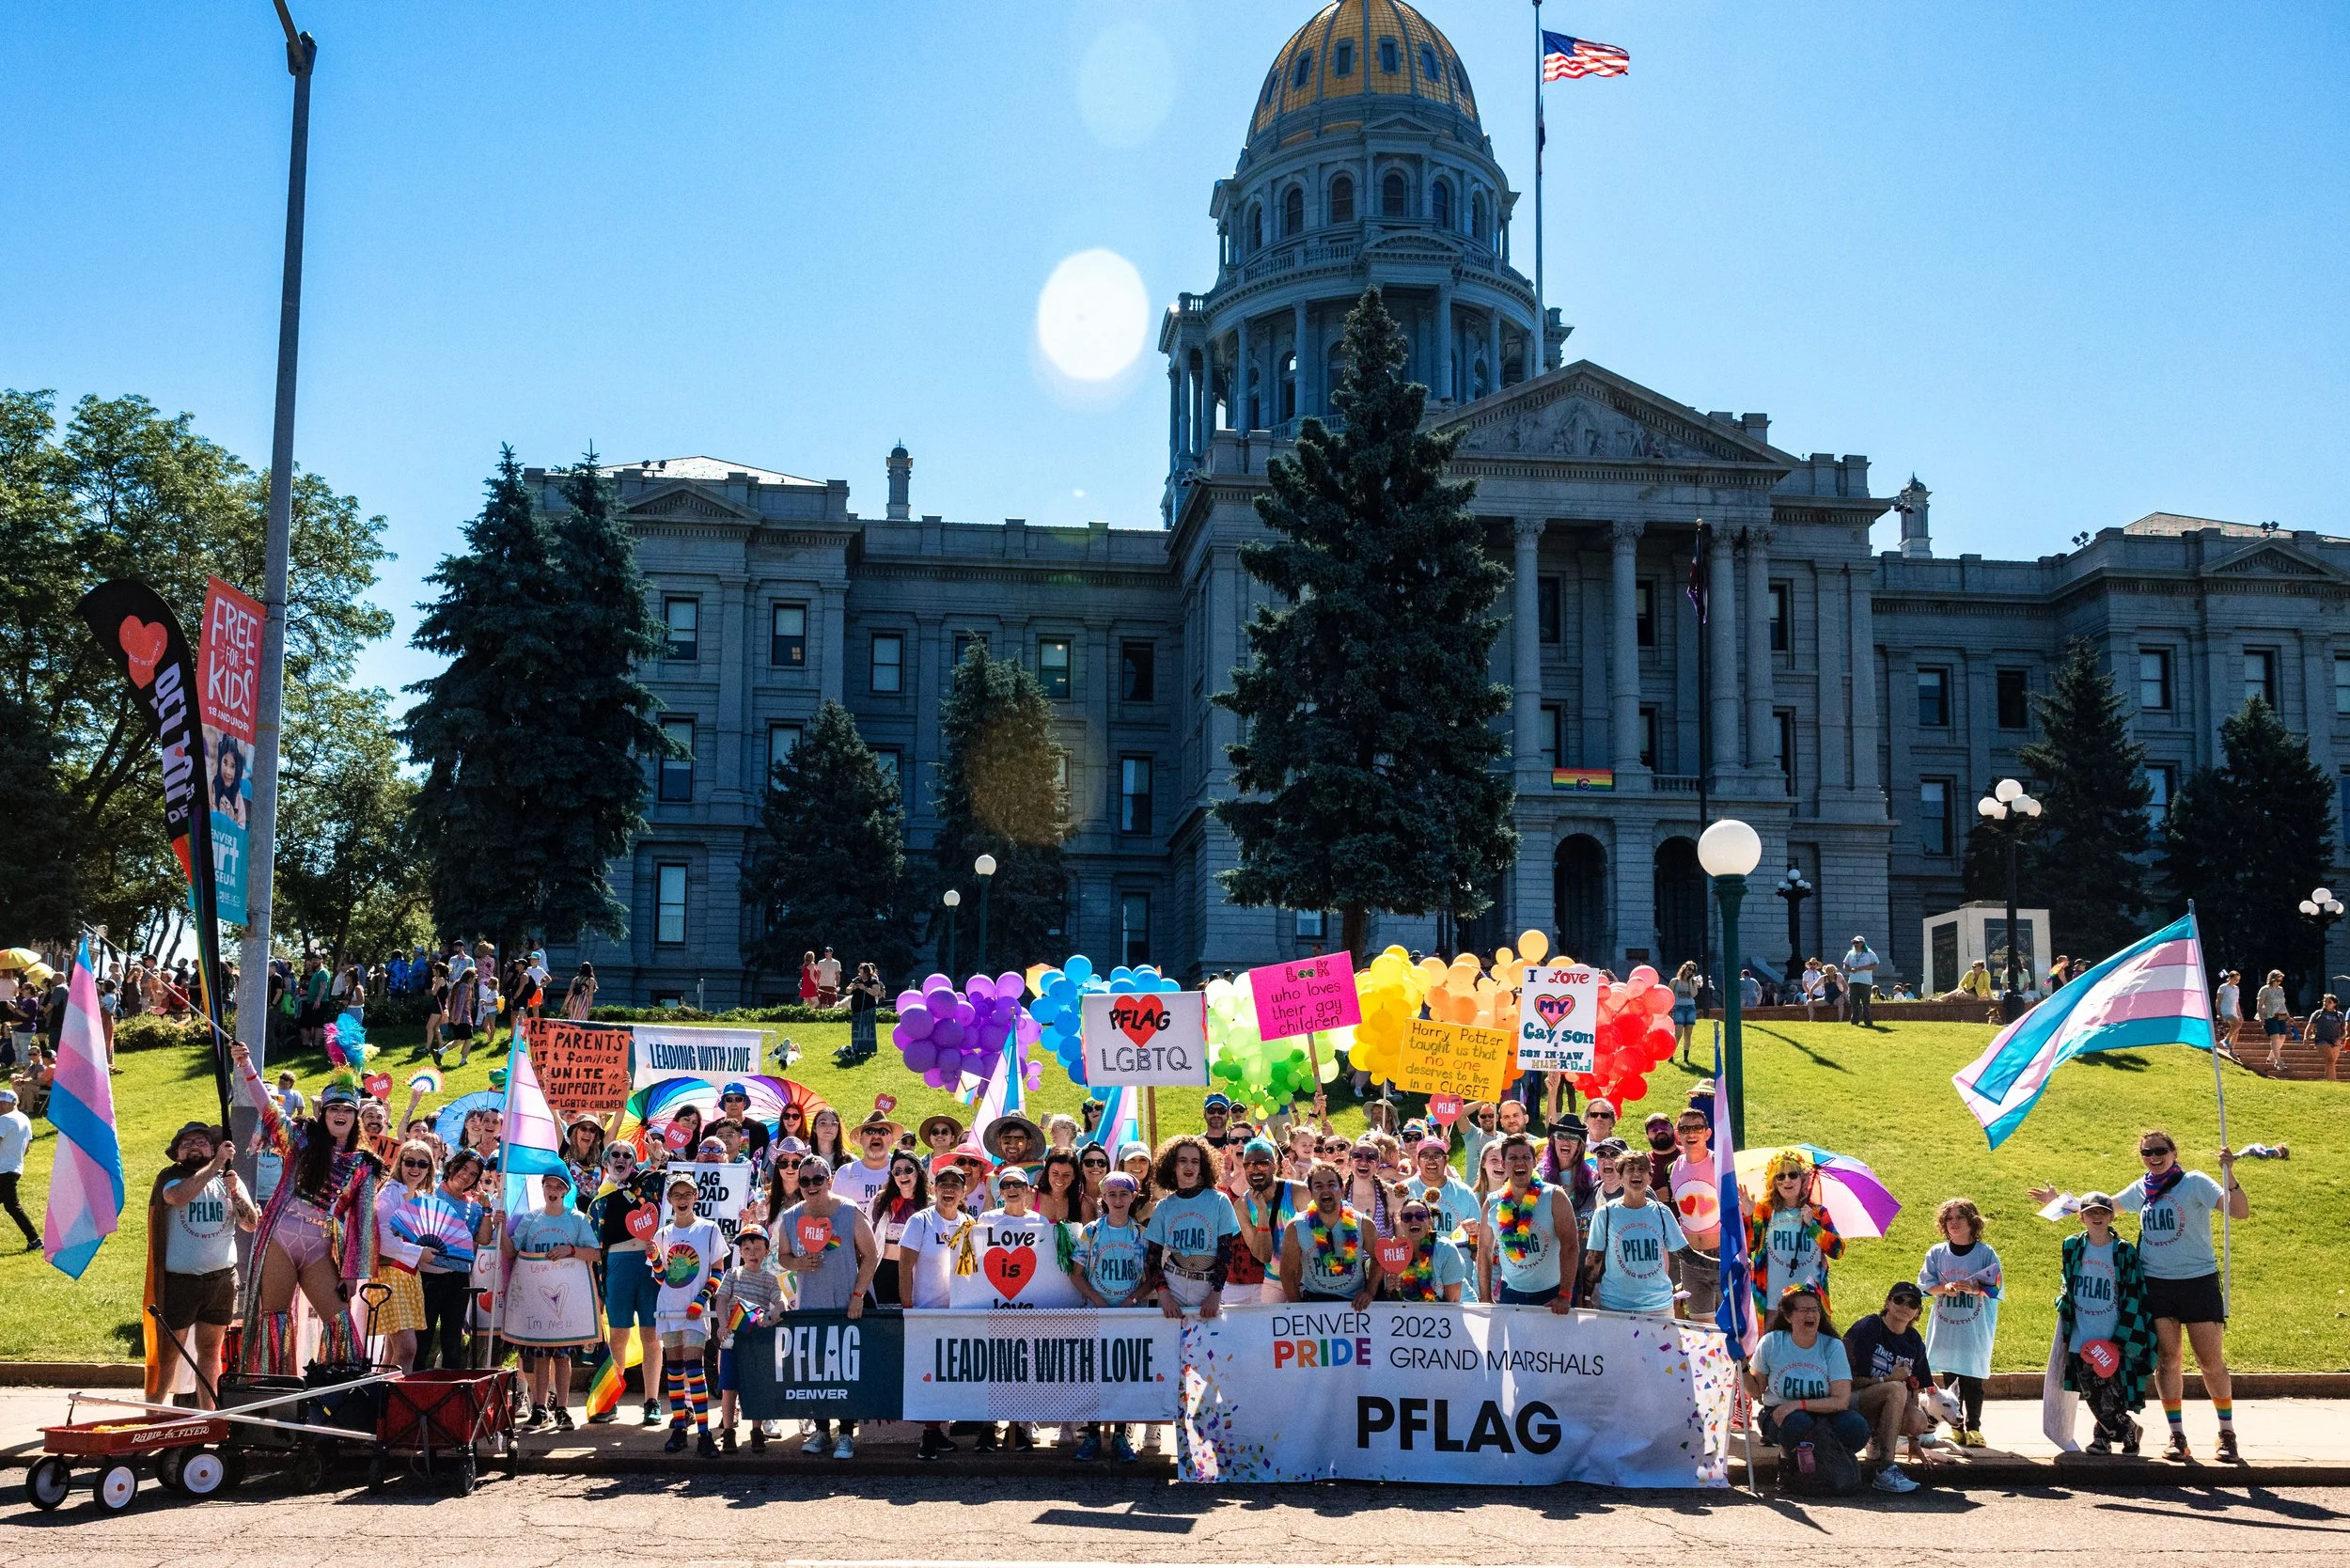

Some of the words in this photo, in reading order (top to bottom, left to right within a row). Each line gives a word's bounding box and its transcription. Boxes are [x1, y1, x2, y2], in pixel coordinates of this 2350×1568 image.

[211, 596, 258, 666] FREE
[226, 645, 239, 669] FOR
[208, 650, 254, 717] KIDS
[208, 706, 217, 717] 18
[217, 711, 230, 723] AND
[229, 716, 250, 733] UNDER
[1528, 969, 1538, 982] I
[1271, 986, 1301, 1003] who
[1306, 981, 1341, 996] loves
[1272, 1004, 1306, 1020] their
[1316, 998, 1342, 1018] gay
[1539, 999, 1570, 1014] MY
[1108, 1008, 1171, 1031] PFLAG
[1279, 1015, 1340, 1036] children
[554, 1031, 625, 1052] PARENTS
[1412, 1022, 1450, 1043] Harry
[1460, 1027, 1504, 1046] Potter
[1523, 1021, 1557, 1043] Gay
[1560, 1029, 1594, 1044] son
[566, 1051, 619, 1066] families
[650, 1043, 696, 1071] LEADING
[697, 1045, 726, 1072] WITH
[727, 1046, 751, 1073] LOVE
[1409, 1036, 1451, 1056] taught
[1455, 1046, 1468, 1057] us
[1473, 1044, 1497, 1060] that
[1101, 1045, 1192, 1073] LGBTQ
[1425, 1056, 1445, 1067] no
[1452, 1059, 1481, 1072] one
[551, 1067, 603, 1080] UNITE
[608, 1070, 619, 1080] in
[1405, 1062, 1453, 1080] deserves
[1456, 1072, 1467, 1081] to
[1472, 1073, 1490, 1085] live
[1410, 1078, 1419, 1089] in
[1424, 1082, 1433, 1090] a
[371, 1079, 389, 1091] PFLAG
[550, 1082, 606, 1095] SUPPORT
[607, 1083, 621, 1096] for
[589, 1100, 624, 1109] CHILDREN
[1437, 1102, 1456, 1115] PFLAG
[668, 1130, 686, 1144] PFLAG
[189, 1201, 223, 1222] PFLAG
[633, 1214, 653, 1232] PFLAG
[805, 1226, 824, 1241] PFLAG
[987, 1226, 1036, 1247] Love
[1173, 1228, 1205, 1249] PFLAG
[1773, 1230, 1811, 1252] PFLAG
[1384, 1247, 1405, 1262] PFLAG
[1622, 1238, 1659, 1262] PFLAG
[1001, 1258, 1021, 1278] is
[1102, 1259, 1136, 1280] PFLAG
[2074, 1275, 2111, 1301] PFLAG
[1272, 1312, 1371, 1337] DENVER
[1390, 1315, 1451, 1339] 2023
[775, 1325, 861, 1382] PFLAG
[935, 1338, 1028, 1383] LEADING
[1034, 1338, 1094, 1383] WITH
[1101, 1338, 1153, 1383] LOVE
[1273, 1337, 1371, 1369] PRIDE
[1389, 1346, 1479, 1371] GRAND
[1487, 1350, 1605, 1376] MARSHALS
[2091, 1344, 2113, 1368] PFLAG
[785, 1388, 848, 1400] DENVER
[1783, 1376, 1825, 1399] PFLAG
[131, 1431, 164, 1444] RADIO
[178, 1425, 210, 1437] FLYER
[1356, 1395, 1562, 1455] PFLAG
